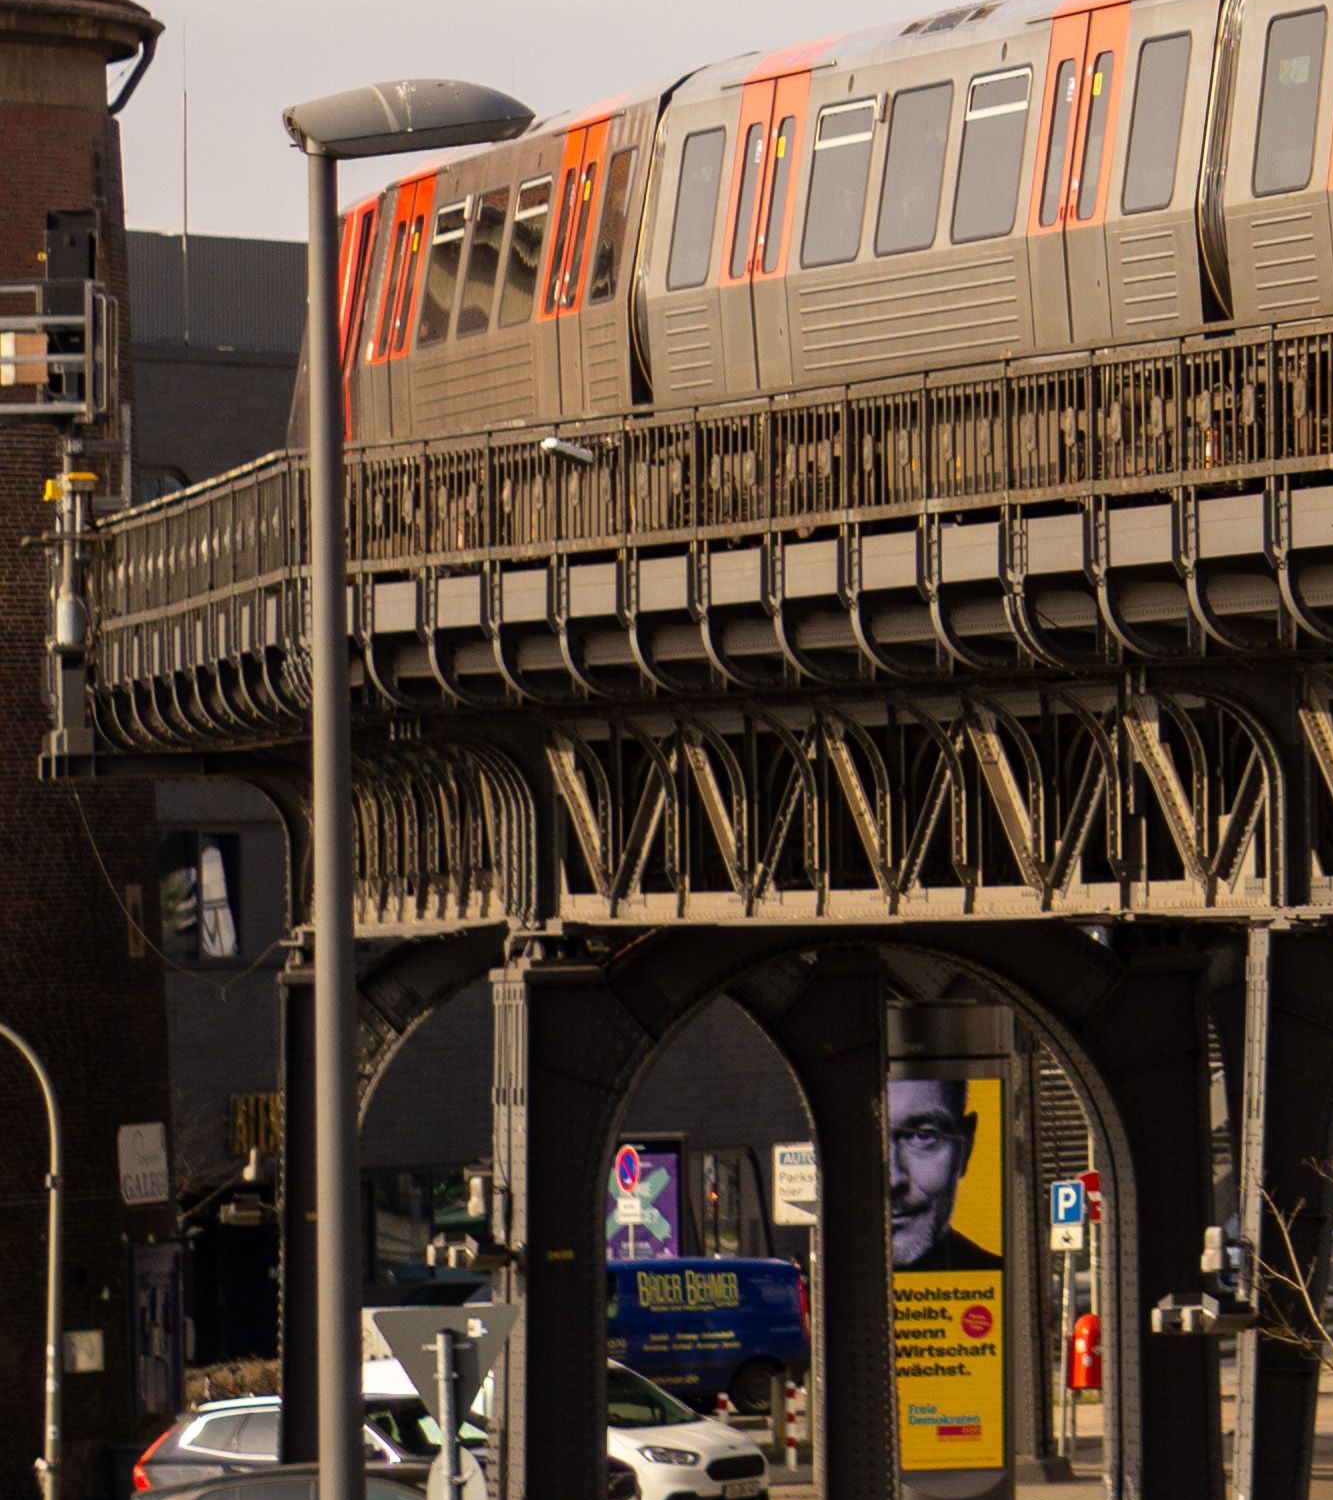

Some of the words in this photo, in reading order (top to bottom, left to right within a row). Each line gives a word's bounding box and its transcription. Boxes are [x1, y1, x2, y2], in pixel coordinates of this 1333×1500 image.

[1058, 1187, 1077, 1220] P
[894, 1286, 994, 1302] Wohlstand
[895, 1328, 946, 1339] wenn
[896, 1343, 997, 1358] Wirtschaft
[897, 1362, 970, 1377] wächst.
